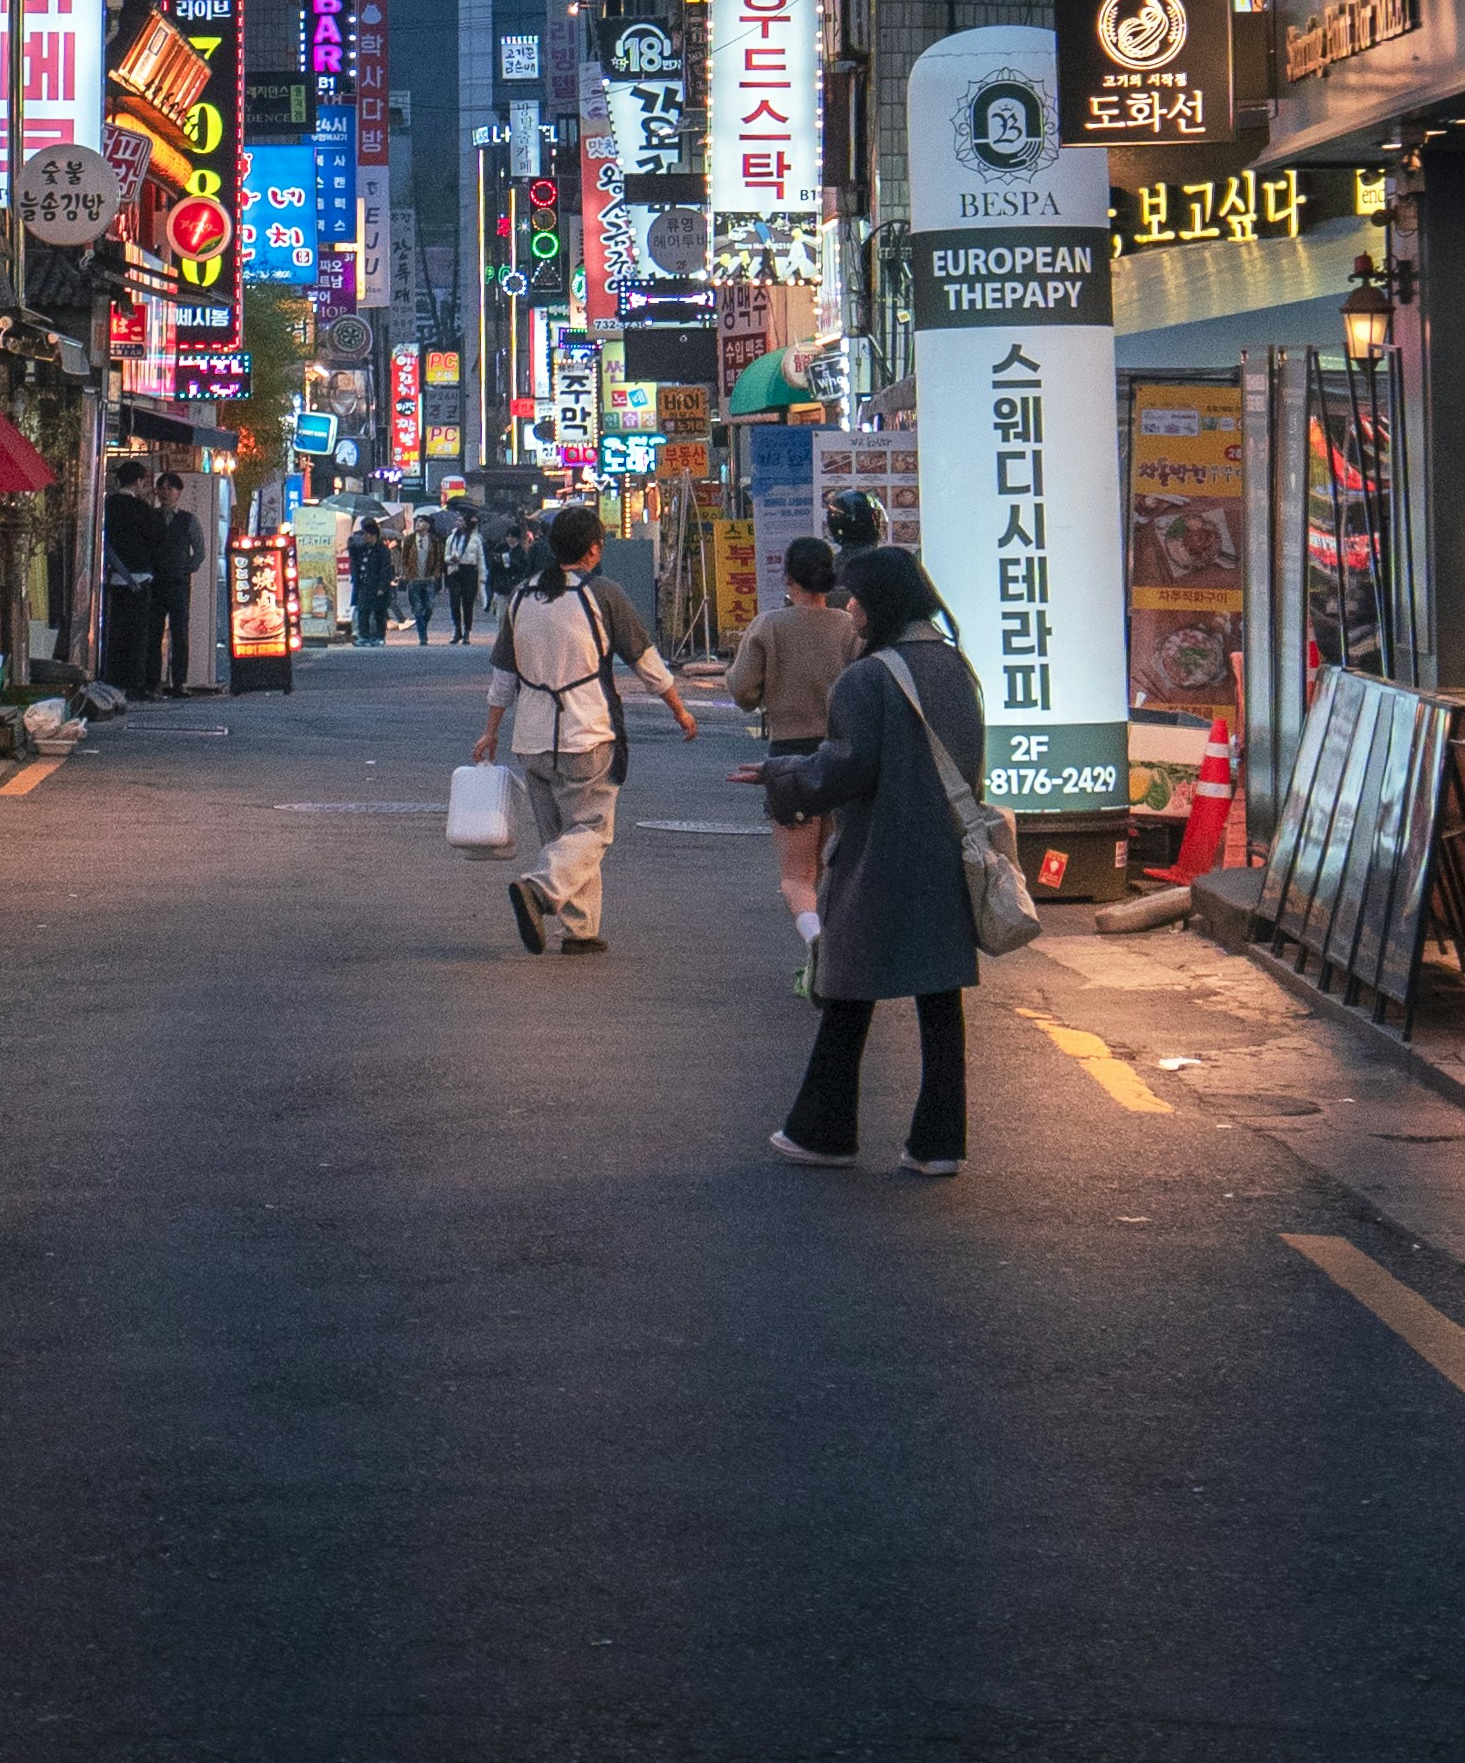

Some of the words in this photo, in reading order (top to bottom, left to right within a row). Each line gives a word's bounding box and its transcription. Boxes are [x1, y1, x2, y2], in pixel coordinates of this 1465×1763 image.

[317, 76, 335, 89] B1
[360, 34, 383, 154] 학사다방
[1102, 73, 1142, 88] 고기의
[1147, 73, 1188, 88] 시작점
[1084, 89, 1207, 134] 도화선
[40, 160, 85, 186] 숯불
[20, 189, 103, 222] 늘솜김밥
[959, 191, 1061, 218] BESPA
[1134, 169, 1307, 243] 보고싶다
[933, 246, 1092, 278] EUROPEAN
[943, 281, 1082, 311] THEPAPY
[430, 353, 458, 370] PC
[559, 374, 592, 437] 주막
[430, 427, 458, 442] PC
[664, 444, 706, 468] 부동산
[990, 341, 1053, 712] 스웨디시테라피
[1010, 735, 1050, 762] 2F
